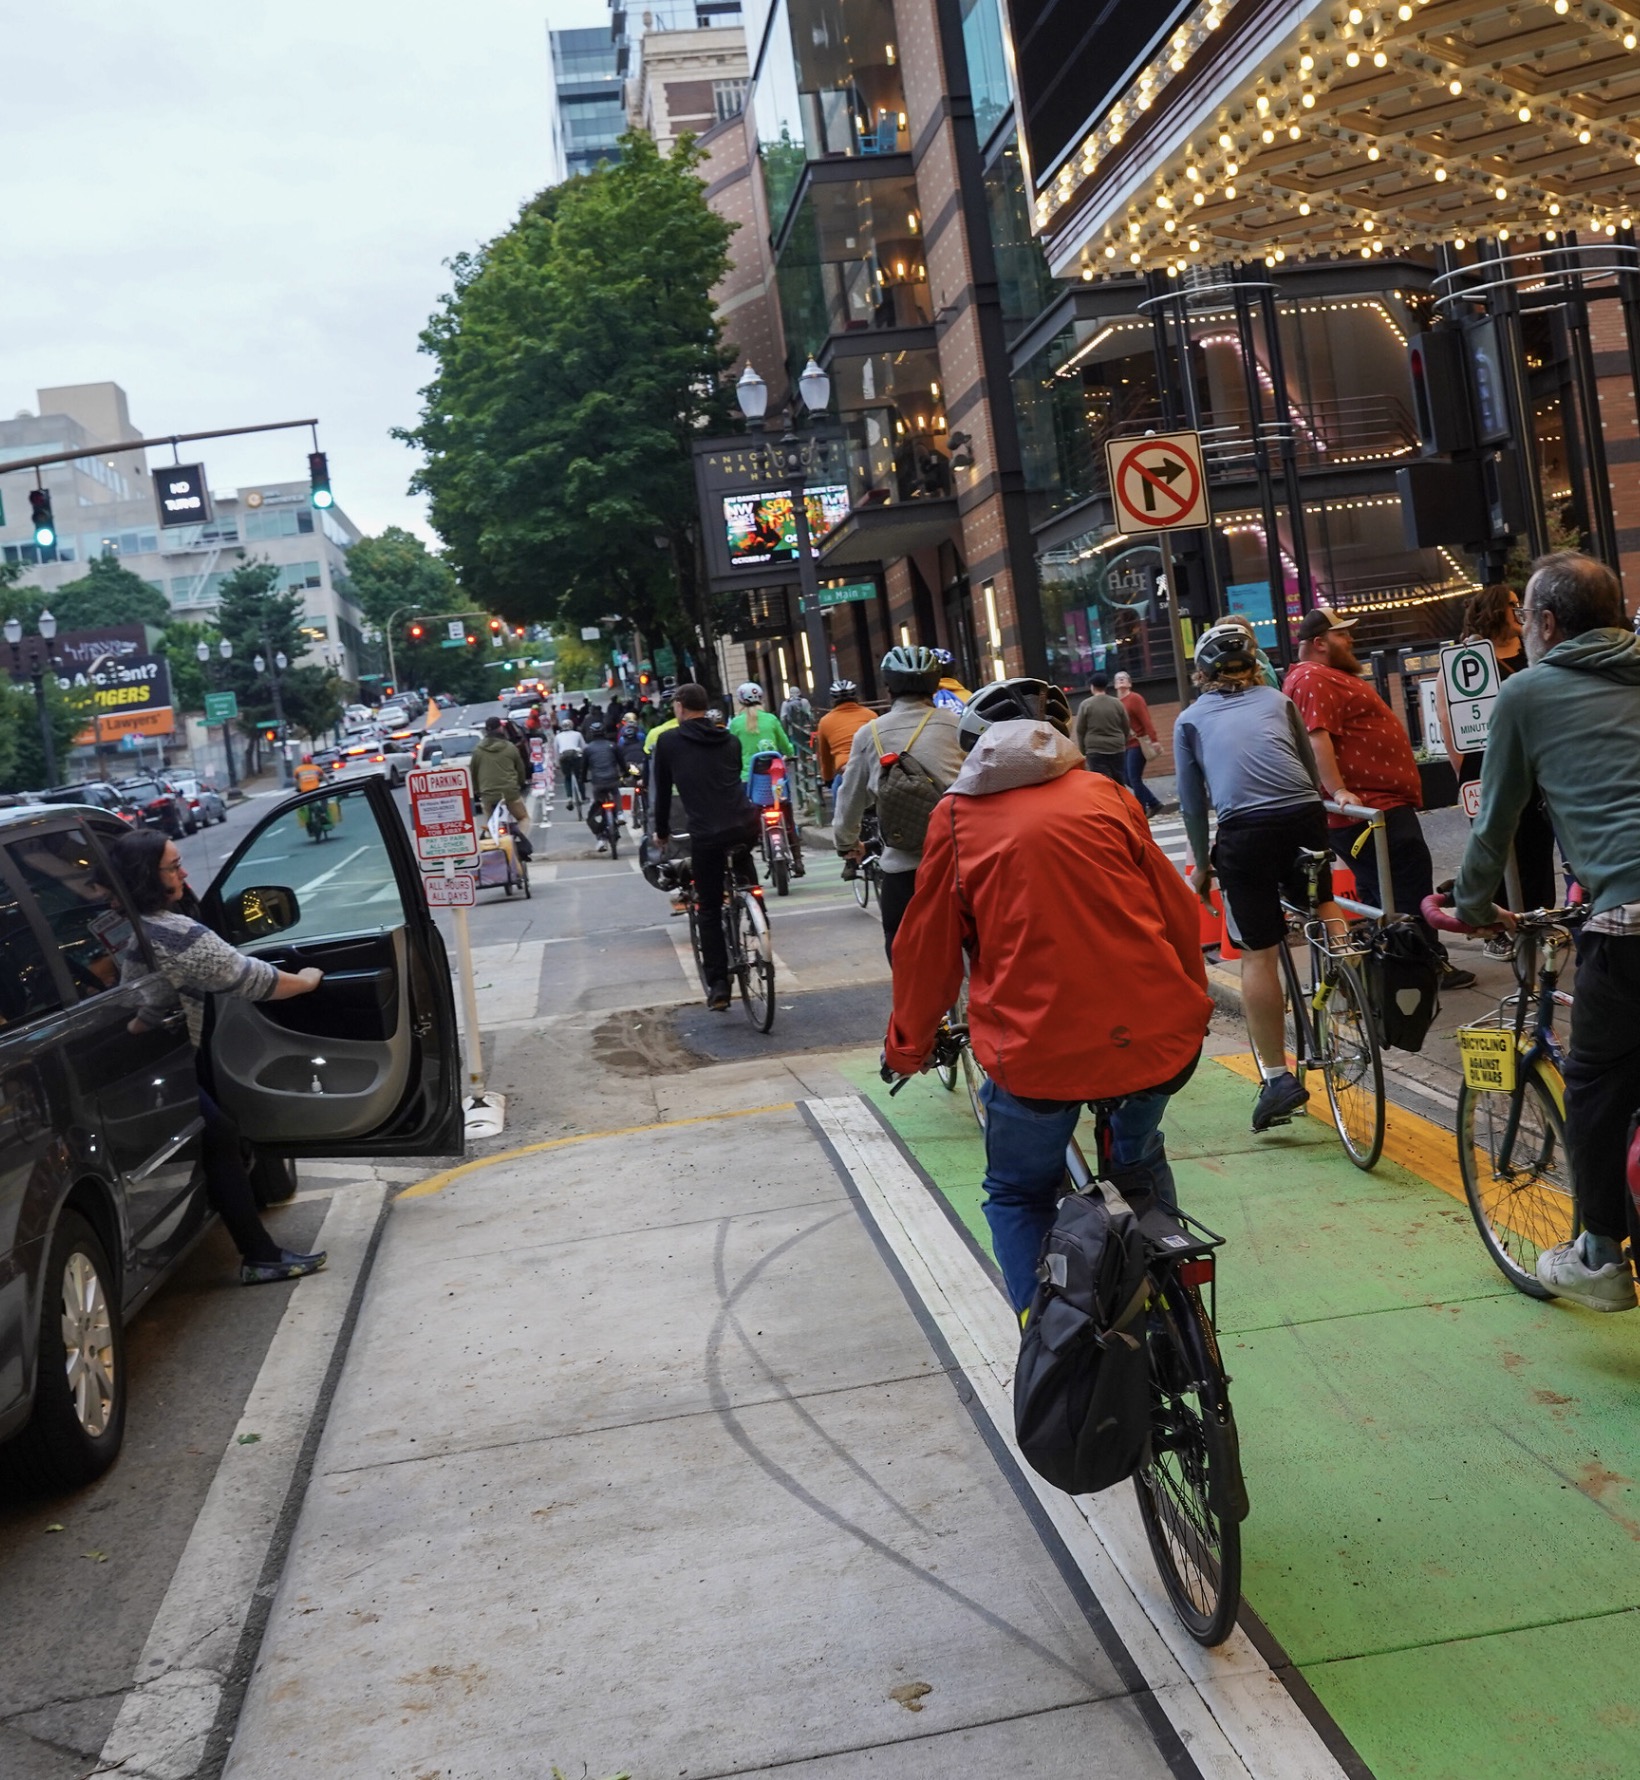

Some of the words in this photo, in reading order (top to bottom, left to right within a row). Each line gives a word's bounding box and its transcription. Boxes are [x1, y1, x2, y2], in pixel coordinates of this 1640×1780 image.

[169, 481, 191, 494] NO
[835, 589, 858, 600] Main
[1462, 658, 1480, 688] P
[1471, 704, 1481, 720] 5
[411, 775, 426, 793] NO
[430, 774, 462, 789] PARKING
[442, 821, 463, 829] SPACE
[429, 882, 443, 891] ALL
[444, 880, 470, 891] HOURS
[432, 892, 446, 902] ALL
[448, 890, 468, 901] DAYS
[1461, 1037, 1506, 1051] BICYCLING
